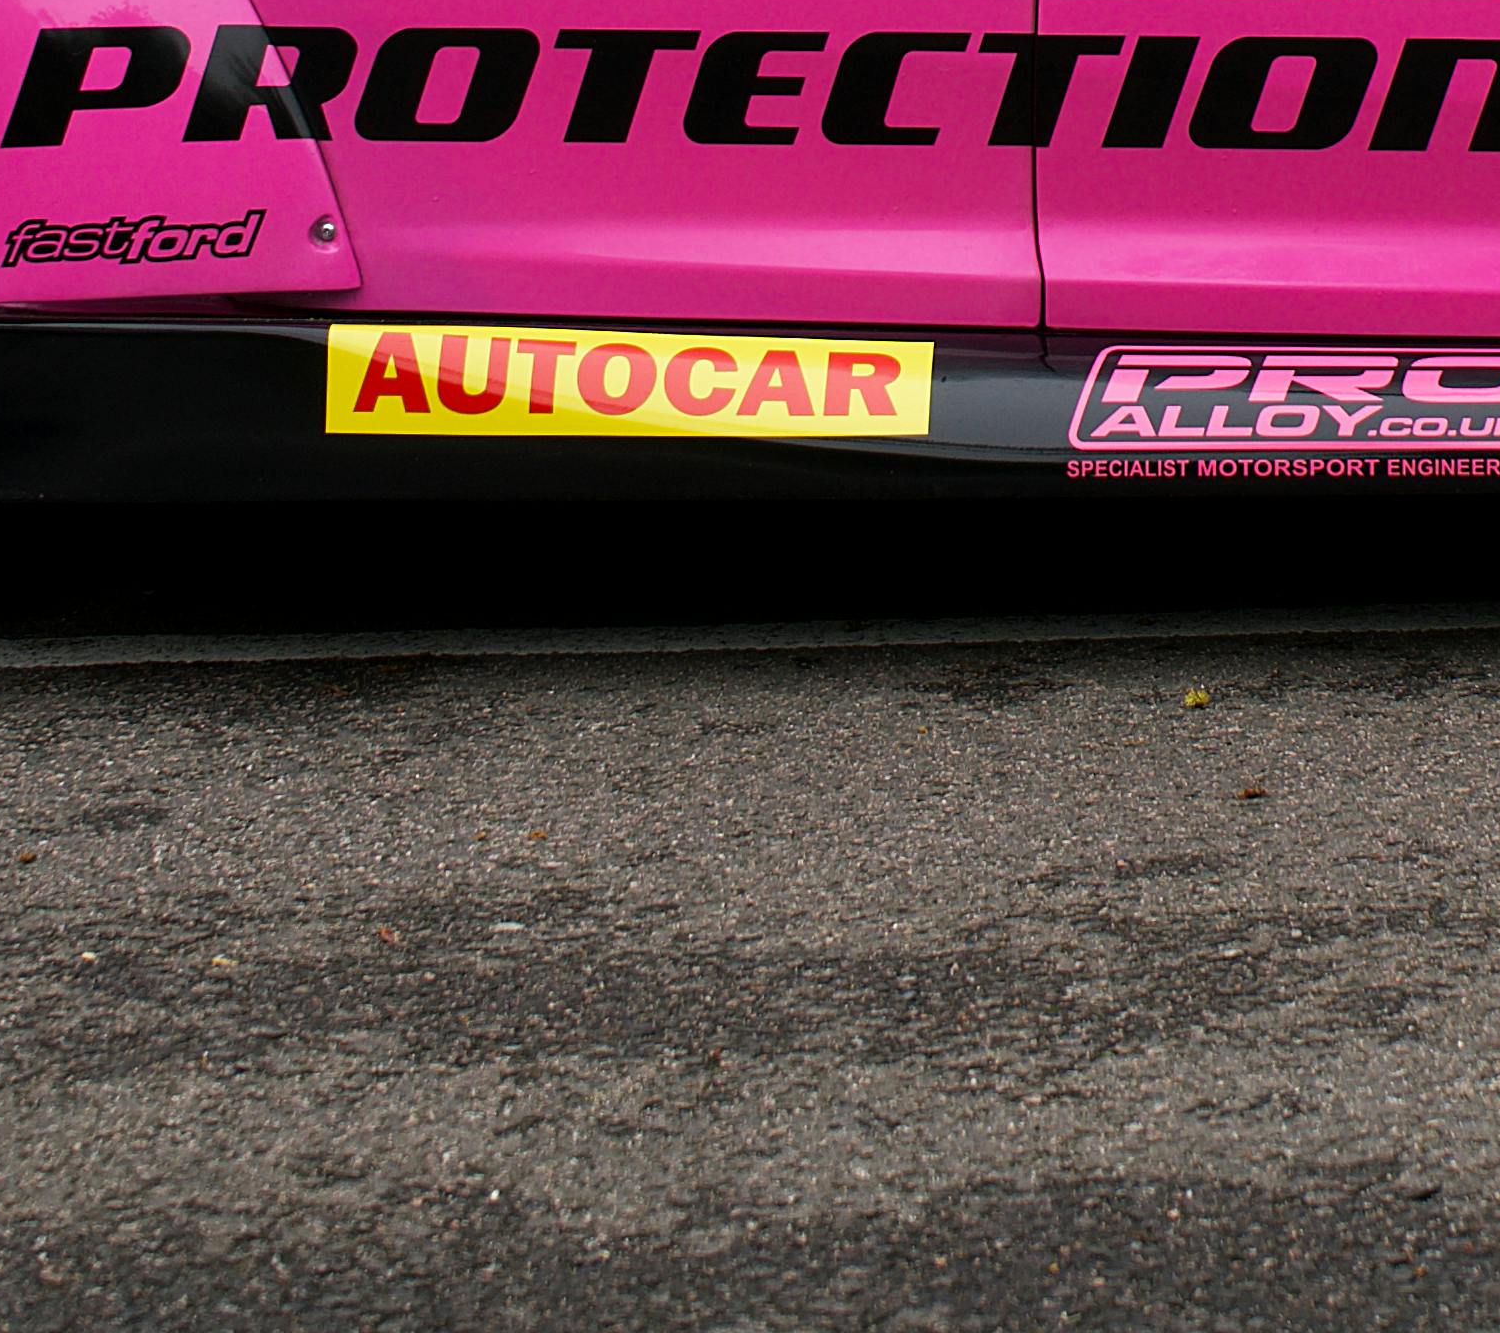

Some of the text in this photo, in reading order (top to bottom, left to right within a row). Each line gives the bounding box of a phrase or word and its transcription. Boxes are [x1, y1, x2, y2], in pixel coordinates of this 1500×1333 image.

[2, 209, 266, 268] fastford
[353, 331, 902, 416] AUTOCAR
[1067, 459, 1189, 478] SPECIALIST
[1197, 458, 1380, 478] MOTORSPORT
